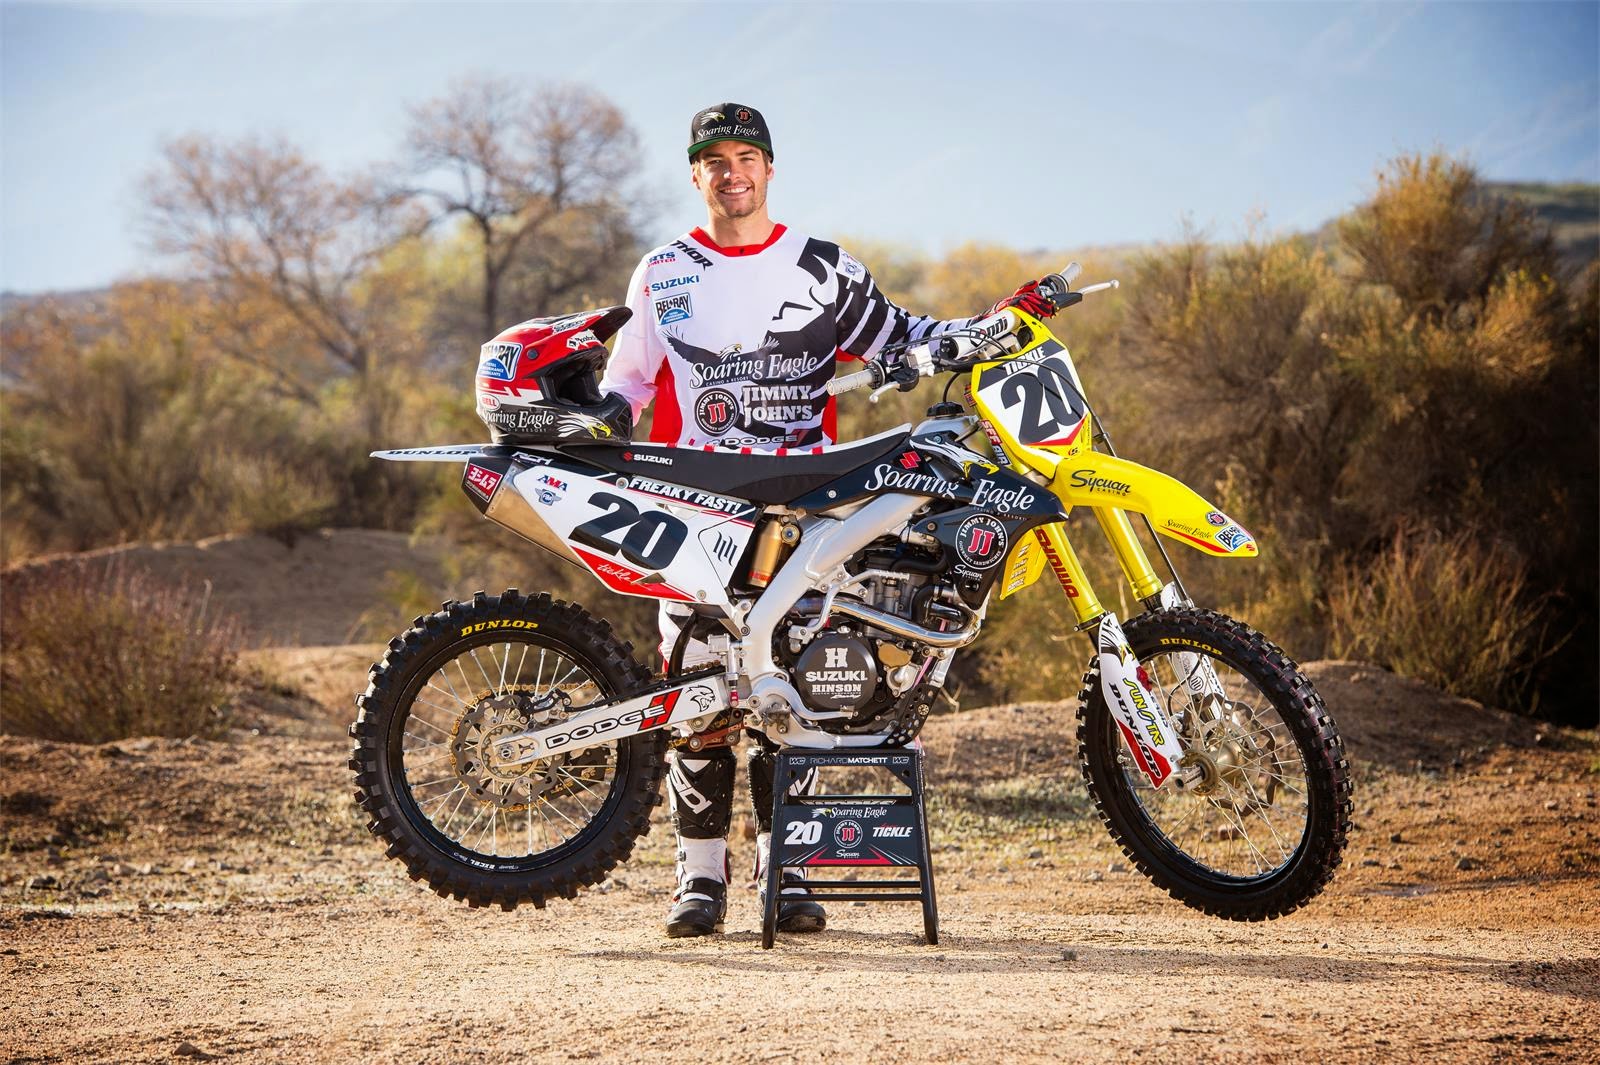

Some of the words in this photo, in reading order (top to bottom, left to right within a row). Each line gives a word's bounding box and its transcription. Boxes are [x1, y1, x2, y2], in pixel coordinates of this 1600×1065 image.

[697, 125, 732, 139] Soaring
[733, 124, 760, 137] Eagle
[670, 239, 714, 271] THOR
[651, 274, 700, 292] SUZUKI
[690, 356, 765, 389] Soaring
[766, 351, 818, 379] Eagle
[742, 385, 812, 407] JIMMY
[1001, 357, 1084, 445] 20
[517, 410, 554, 429] Eagle
[707, 401, 727, 424] JJ
[744, 405, 814, 429] JOHN'S
[724, 435, 798, 446] DODGE
[633, 453, 673, 466] SUZUKI
[537, 474, 568, 492] AMA
[864, 463, 960, 500] Soaring
[969, 478, 1035, 513] Eagle
[1071, 469, 1131, 493] Sycuan
[1097, 487, 1126, 496] CASINO
[629, 478, 693, 500] FREAKY
[693, 492, 742, 514] FAST!
[568, 491, 688, 571] 20
[960, 517, 985, 538] JIMMY
[986, 519, 1005, 548] JOHN'S
[968, 528, 996, 556] JJ
[954, 564, 983, 578] Sycuan
[1036, 528, 1080, 598] SHOWA
[460, 619, 539, 637] DUNLOP
[1160, 638, 1223, 656] DUNLOP
[805, 670, 868, 682] SUZUKI
[812, 683, 862, 693] HINSON
[545, 704, 666, 749] DODGE
[1108, 683, 1163, 779] DUNLOP
[830, 807, 862, 818] Soaring
[863, 807, 887, 818] Eagle
[783, 820, 823, 845] 20
[872, 826, 913, 838] TICKLE
